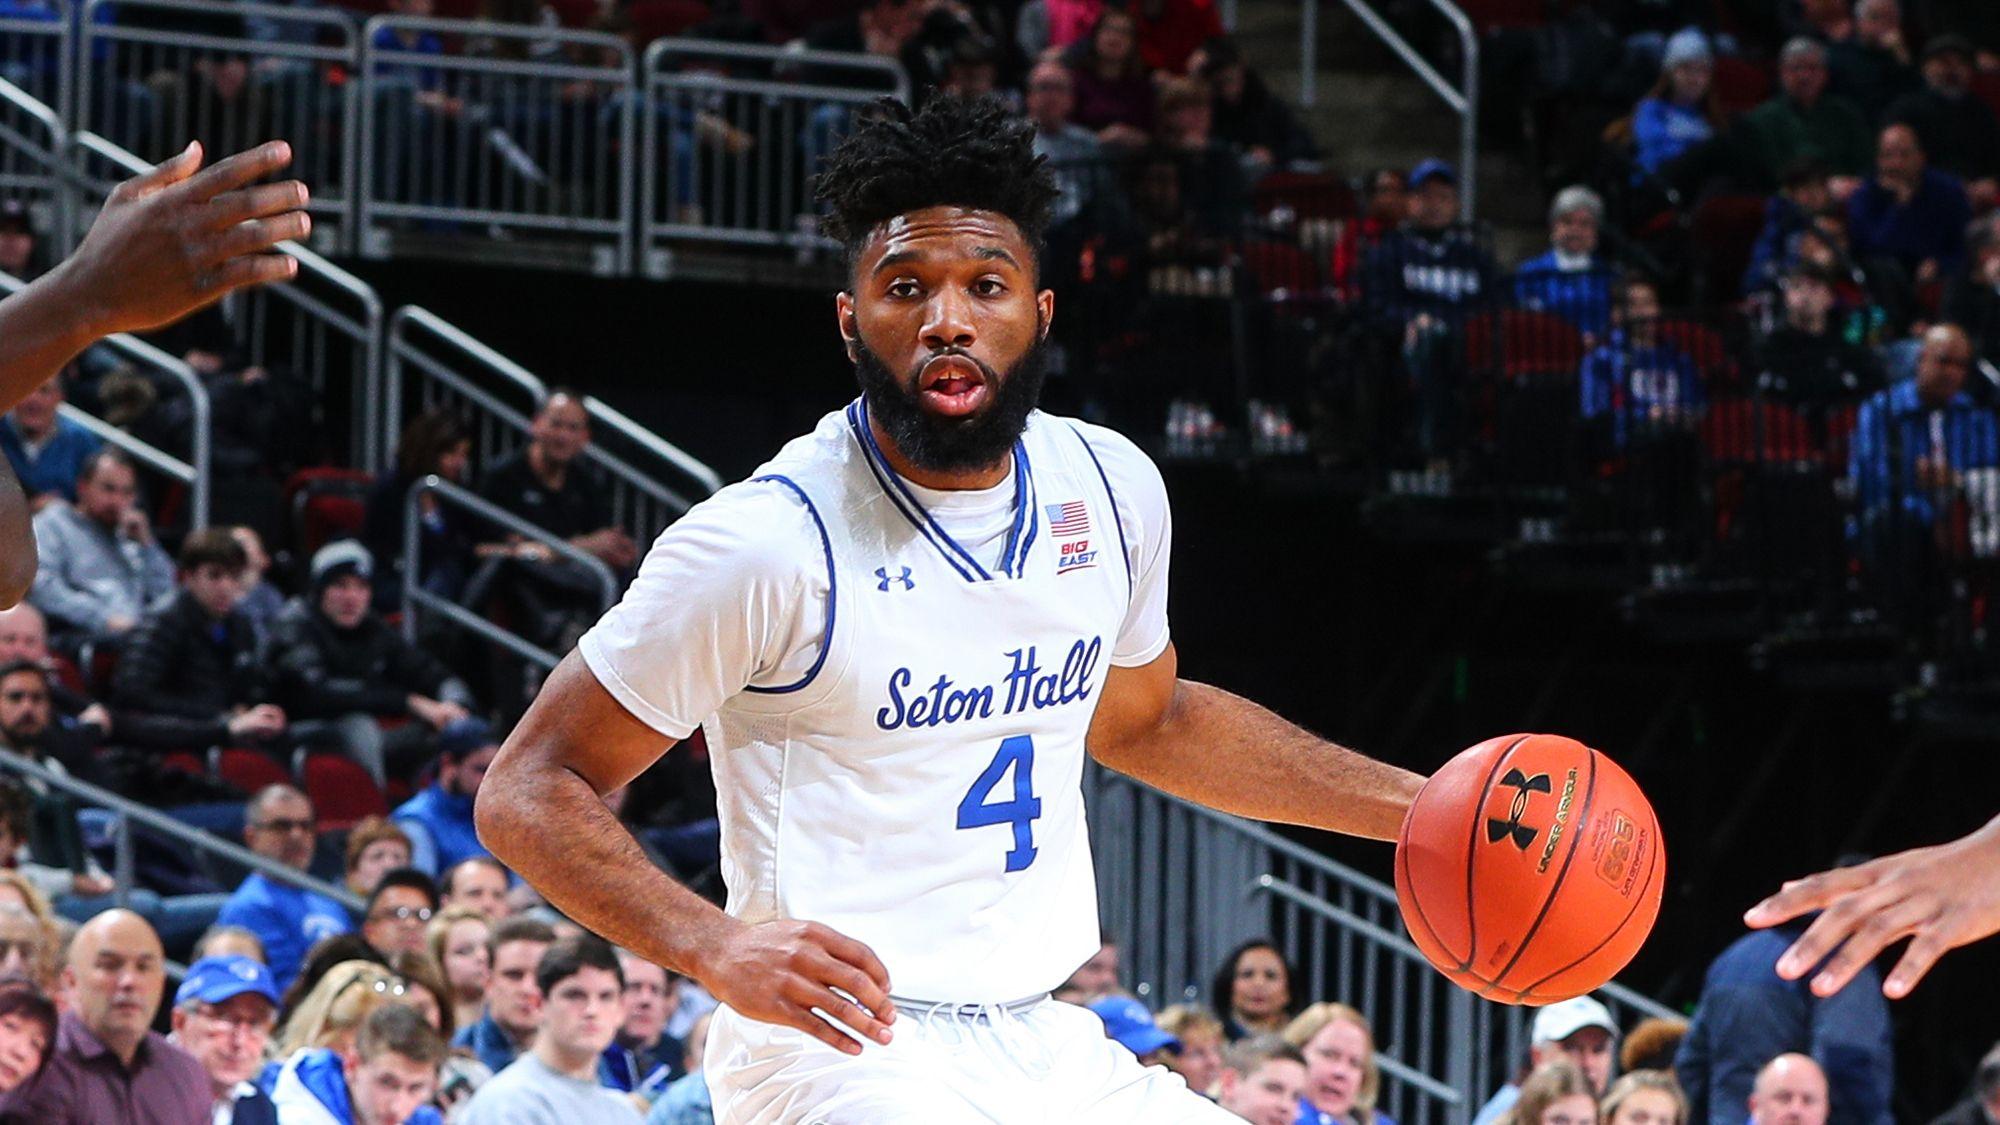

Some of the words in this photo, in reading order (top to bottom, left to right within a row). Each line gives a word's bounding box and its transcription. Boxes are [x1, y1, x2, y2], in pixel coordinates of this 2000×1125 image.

[1058, 550, 1098, 568] EAST
[1061, 540, 1088, 555] BIG
[876, 666, 995, 730] Seton
[1002, 634, 1102, 715] Hall
[956, 734, 1042, 873] 4
[1536, 823, 1564, 874] UNDER
[1556, 769, 1577, 826] ARMOUR
